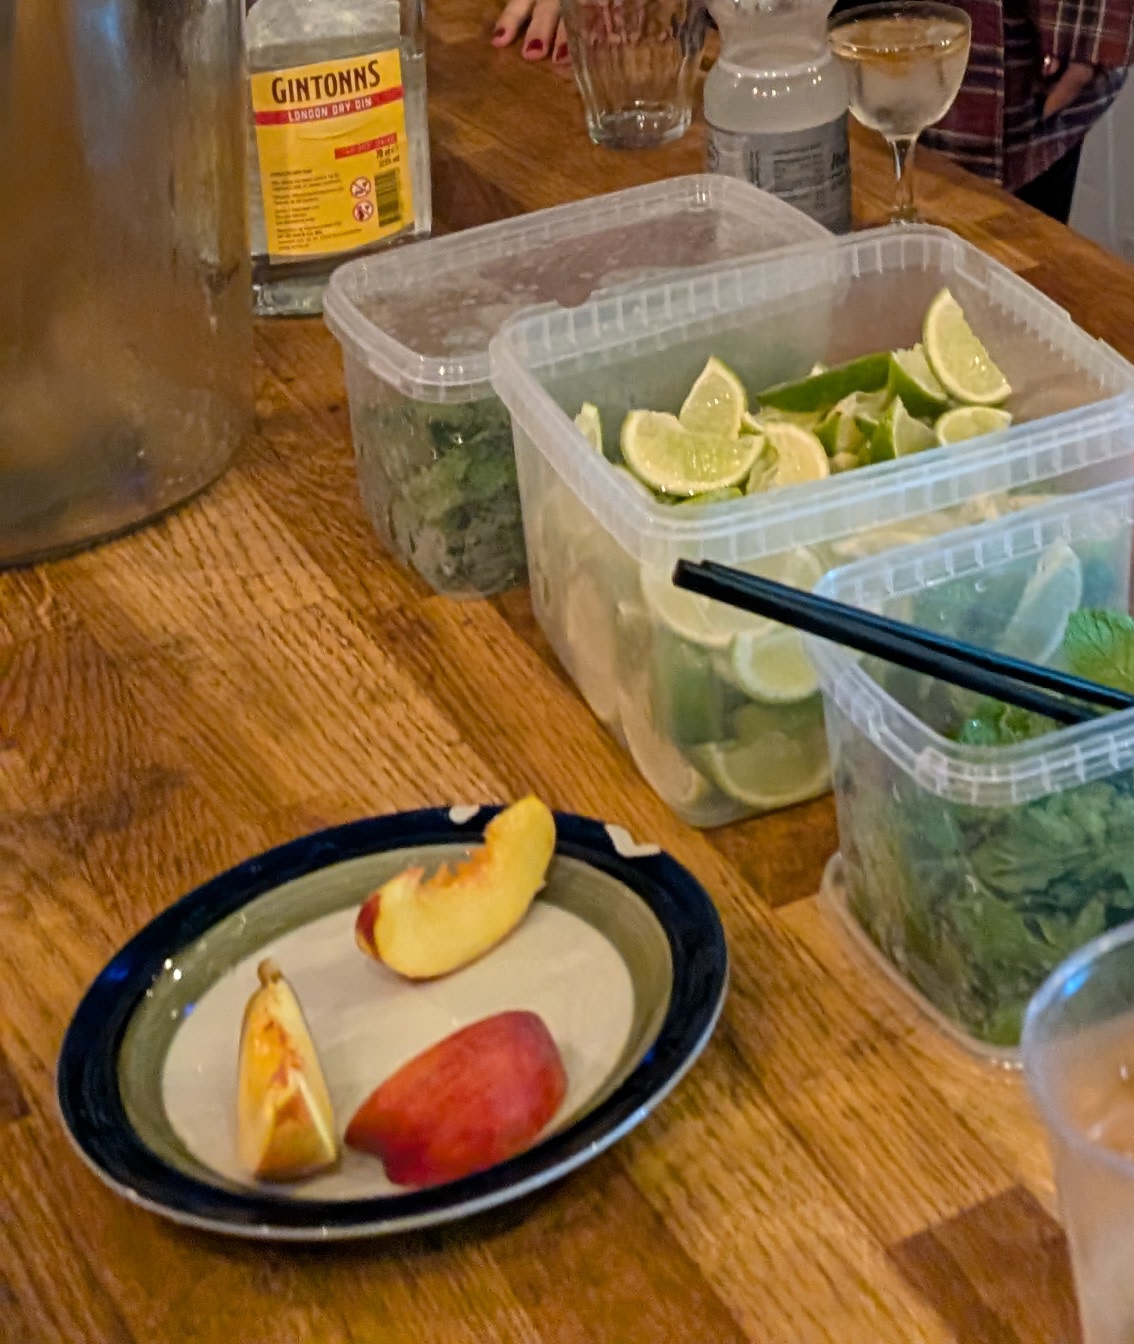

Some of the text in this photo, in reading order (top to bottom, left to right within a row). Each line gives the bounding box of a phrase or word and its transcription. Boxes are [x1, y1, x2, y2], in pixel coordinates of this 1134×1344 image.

[271, 59, 381, 104] GINTONNS
[287, 105, 328, 122] LONDON
[332, 101, 351, 116] DRY
